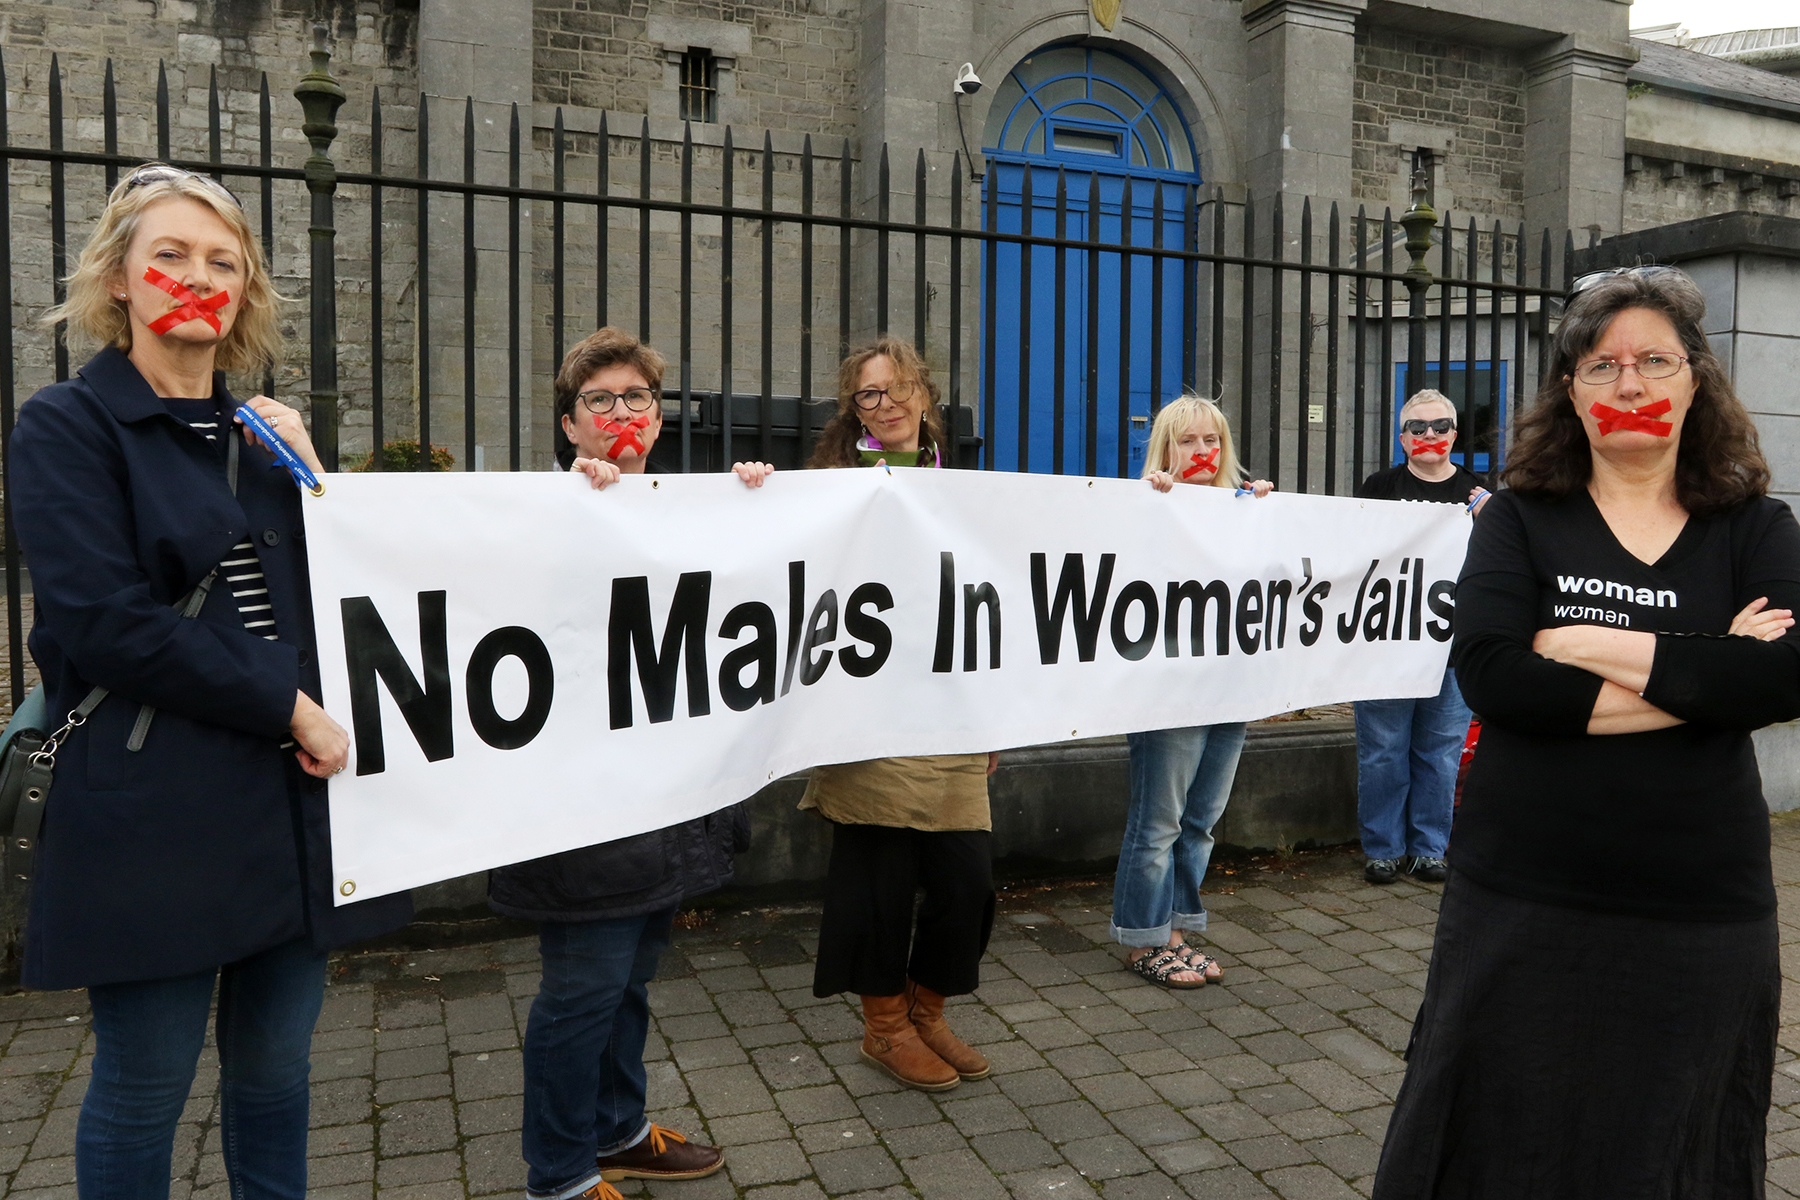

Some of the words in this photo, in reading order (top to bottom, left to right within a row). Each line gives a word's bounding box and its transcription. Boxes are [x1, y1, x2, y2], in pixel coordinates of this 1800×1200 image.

[253, 419, 276, 442] academic
[1557, 575, 1678, 608] woman
[340, 589, 554, 776] No
[607, 560, 894, 730] Males
[932, 551, 1001, 673] In
[1030, 552, 1332, 665] Women's
[1337, 557, 1456, 644] Jails
